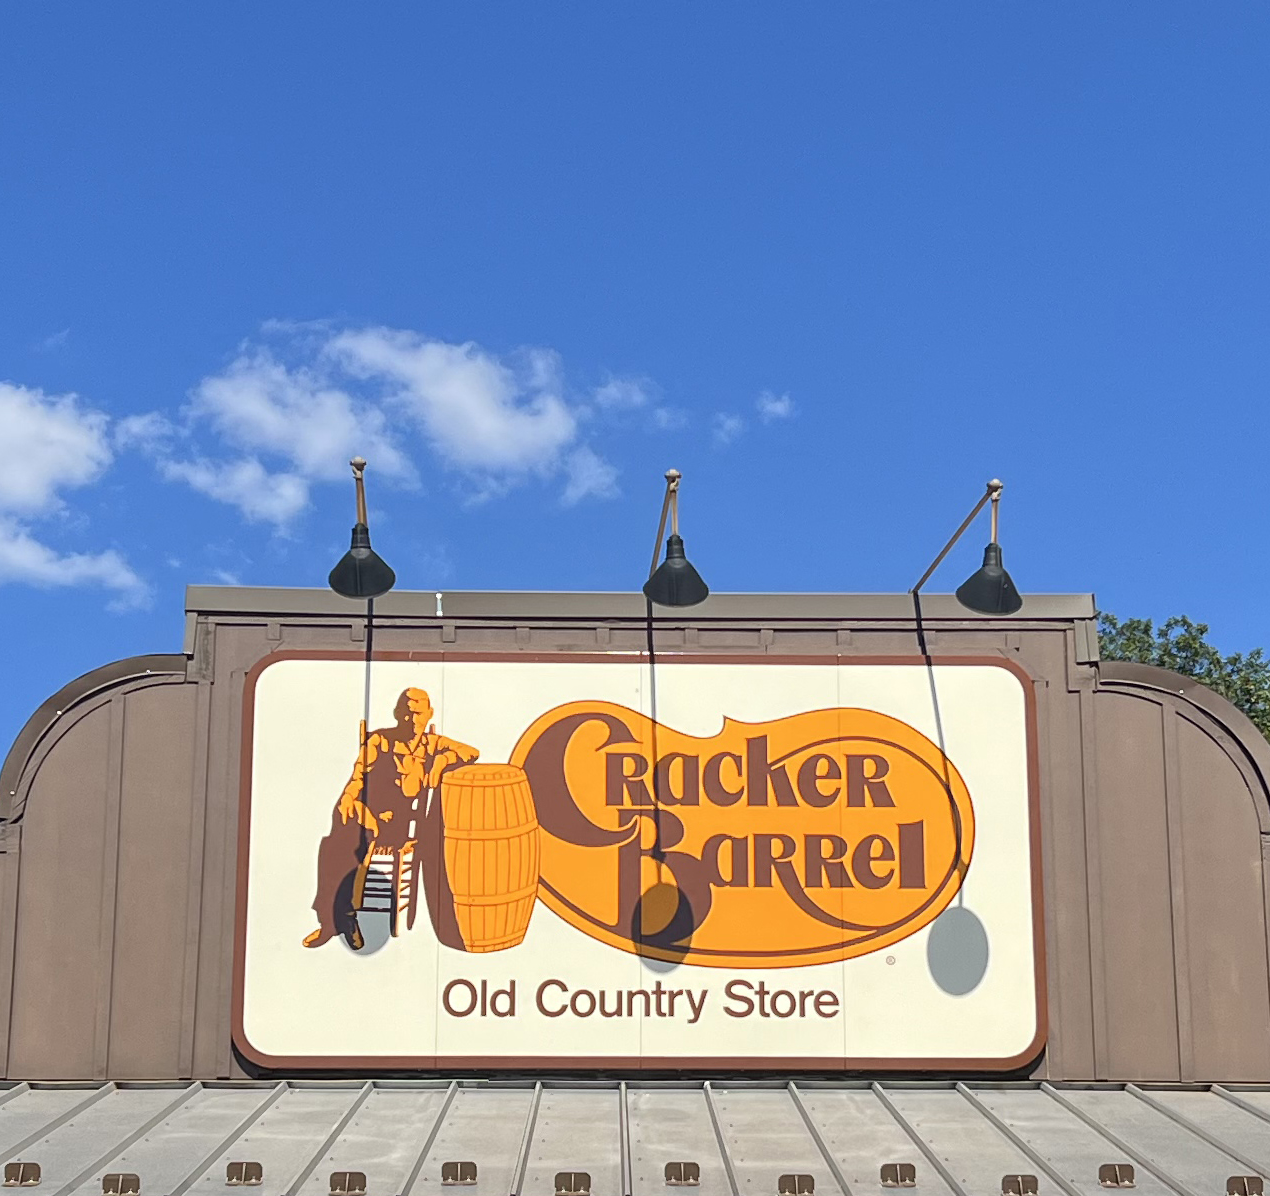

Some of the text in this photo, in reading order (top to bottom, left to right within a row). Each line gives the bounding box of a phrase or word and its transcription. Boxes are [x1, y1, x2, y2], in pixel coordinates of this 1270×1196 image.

[522, 711, 898, 848] Cracker
[616, 806, 928, 928] Barrel
[442, 979, 840, 1024] Old Country Store
